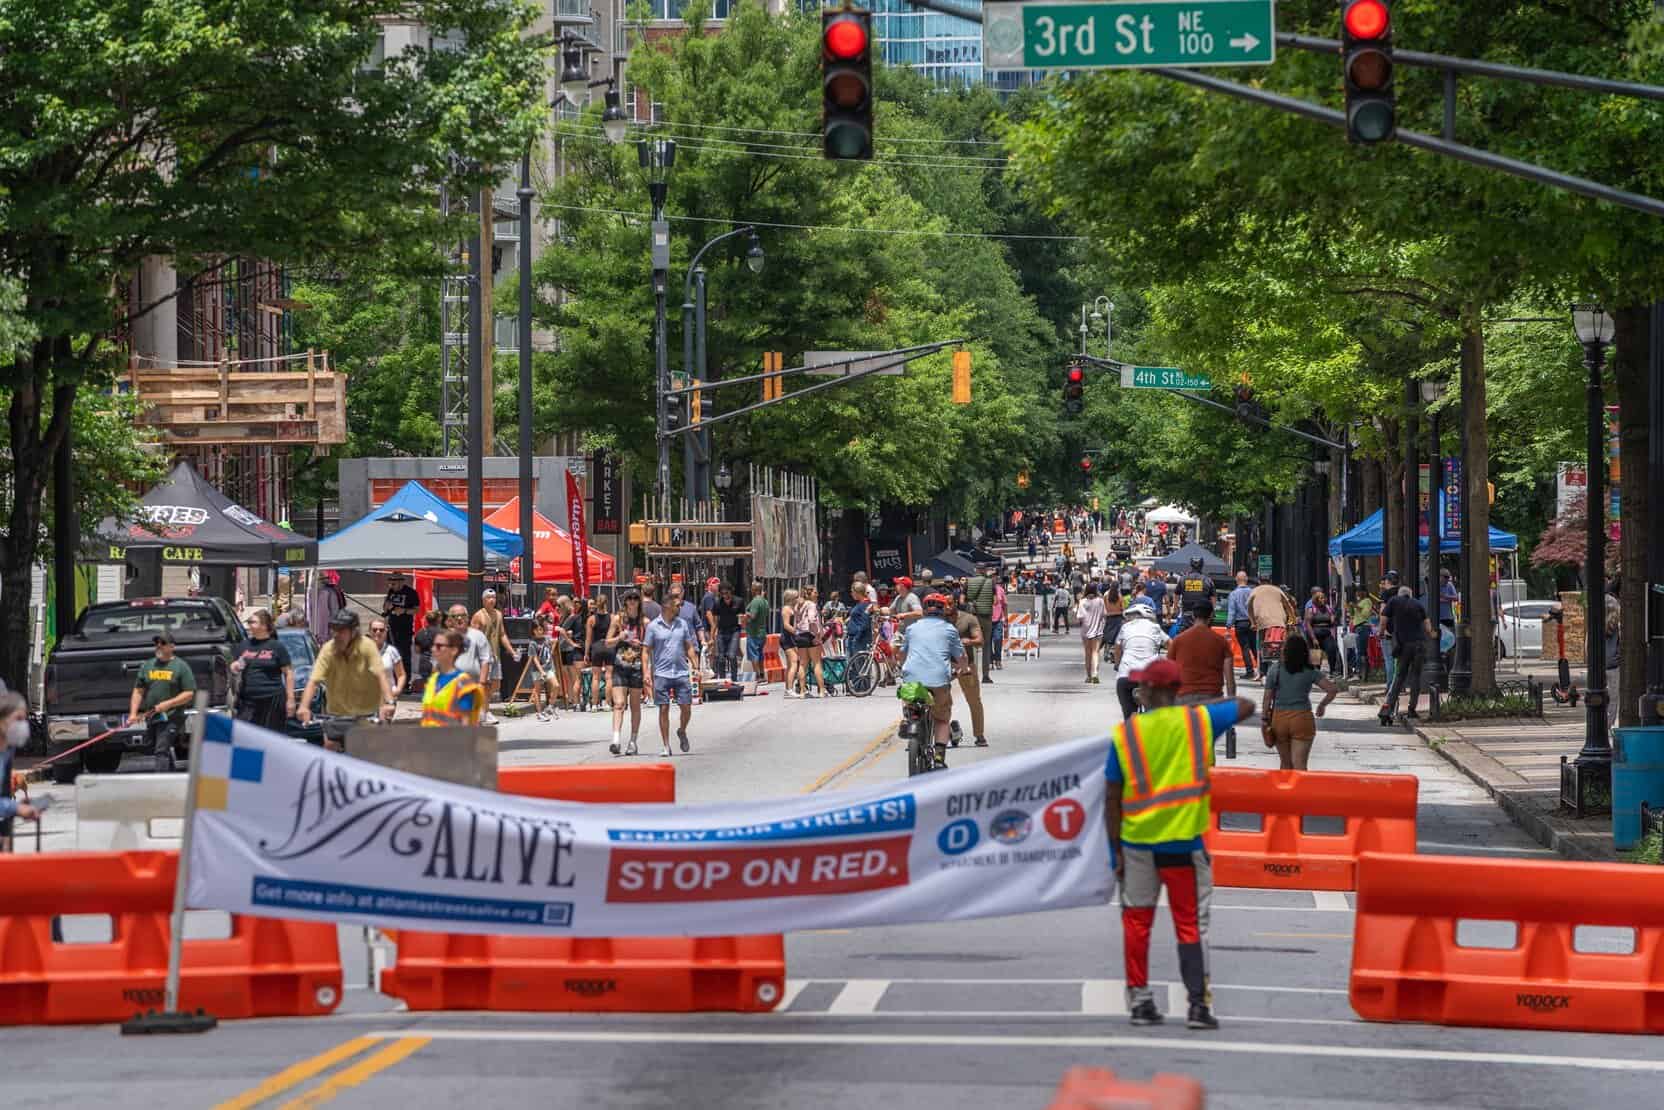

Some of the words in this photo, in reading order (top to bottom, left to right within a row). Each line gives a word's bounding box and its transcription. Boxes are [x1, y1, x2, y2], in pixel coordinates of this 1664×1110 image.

[1178, 10, 1205, 32] NE
[1034, 15, 1095, 56] 3rd
[1115, 14, 1154, 55] St
[1179, 33, 1214, 55] 100
[1136, 370, 1156, 385] 4th
[1161, 370, 1175, 385] St
[163, 546, 203, 560] CAFE
[946, 791, 986, 817] CITY
[986, 788, 1010, 809] OF
[1010, 773, 1082, 803] ATLANTA
[780, 799, 907, 832] STREETS!
[1052, 805, 1076, 833] T
[423, 803, 575, 888] ALIVE
[947, 824, 971, 849] D
[618, 859, 730, 890] STOP
[741, 857, 800, 886] ON
[811, 849, 899, 882] RED.
[256, 883, 282, 901] Get
[284, 889, 324, 905] more
[326, 890, 355, 907] info
[357, 895, 374, 908] at
